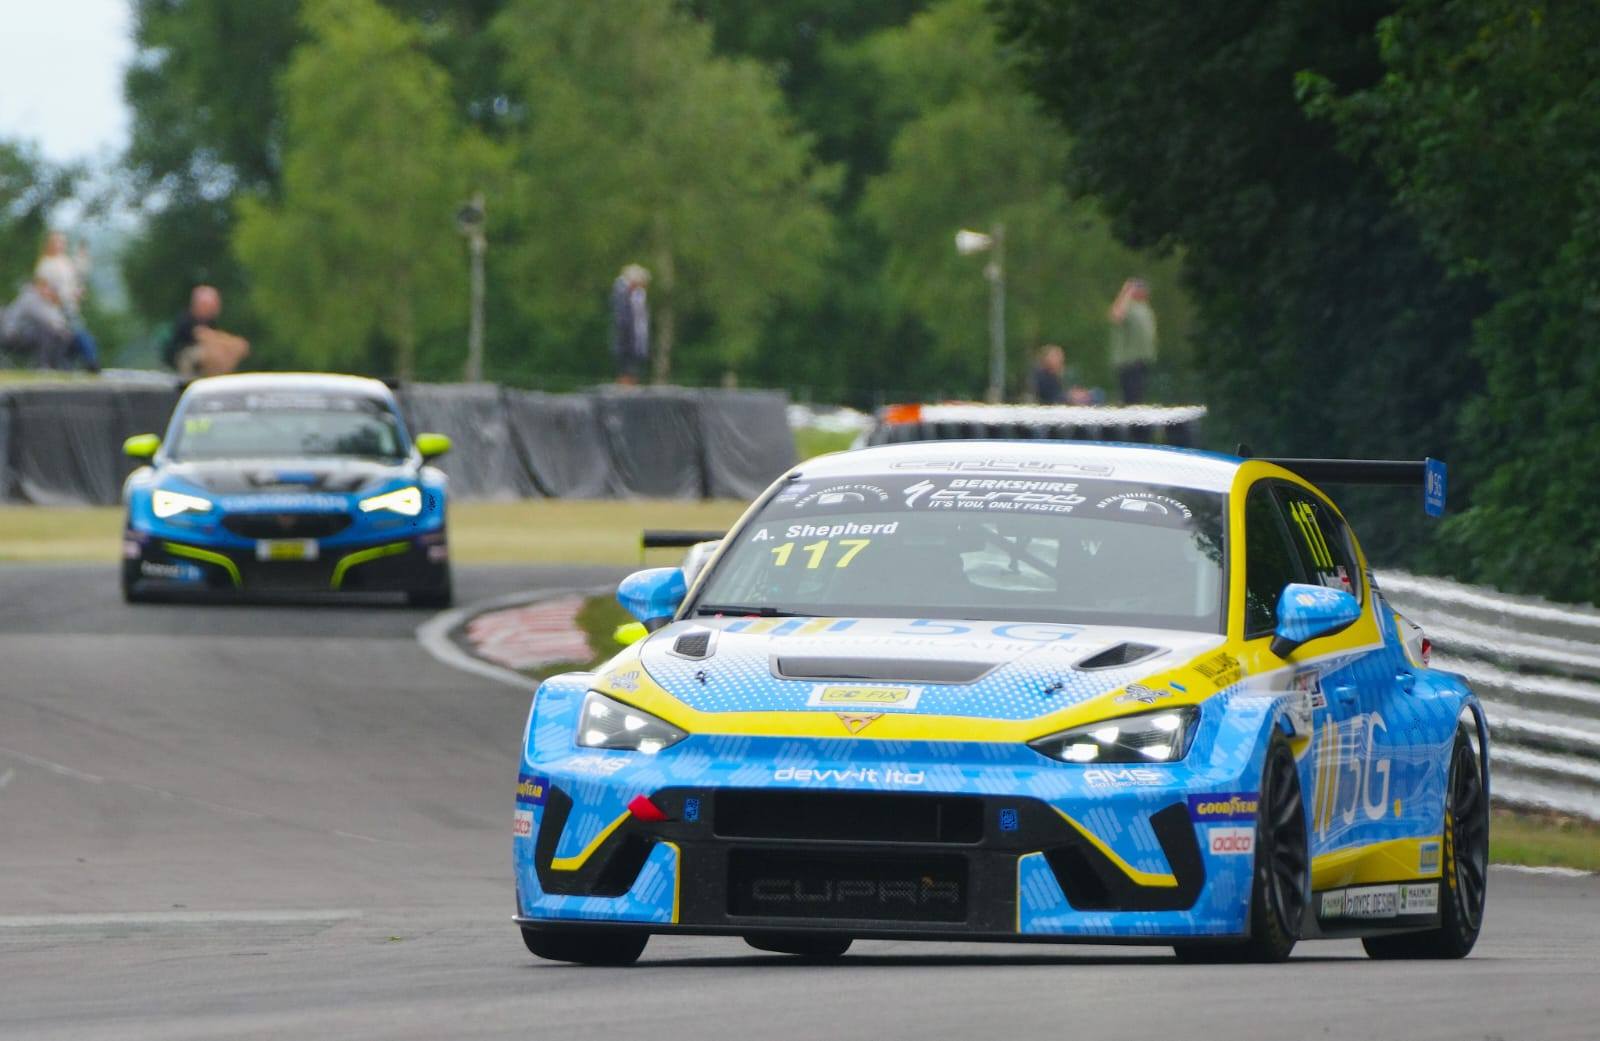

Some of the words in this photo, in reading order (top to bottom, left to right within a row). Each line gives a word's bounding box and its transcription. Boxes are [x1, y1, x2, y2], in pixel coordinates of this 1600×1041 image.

[949, 479, 1079, 492] BERKSHIRE
[928, 488, 1088, 505] turbo
[928, 500, 955, 509] IT'S
[957, 501, 985, 510] YOU,
[988, 502, 1020, 511] ONLY
[1023, 503, 1074, 514] FASTER
[751, 529, 775, 542] A.
[785, 521, 899, 539] Shepherd
[770, 538, 872, 570] 117
[894, 618, 1088, 642] 5G
[885, 768, 925, 786] ltd
[1083, 768, 1165, 786] AMS
[1196, 796, 1259, 816] GOODYEAR
[752, 877, 959, 903] CUPRA
